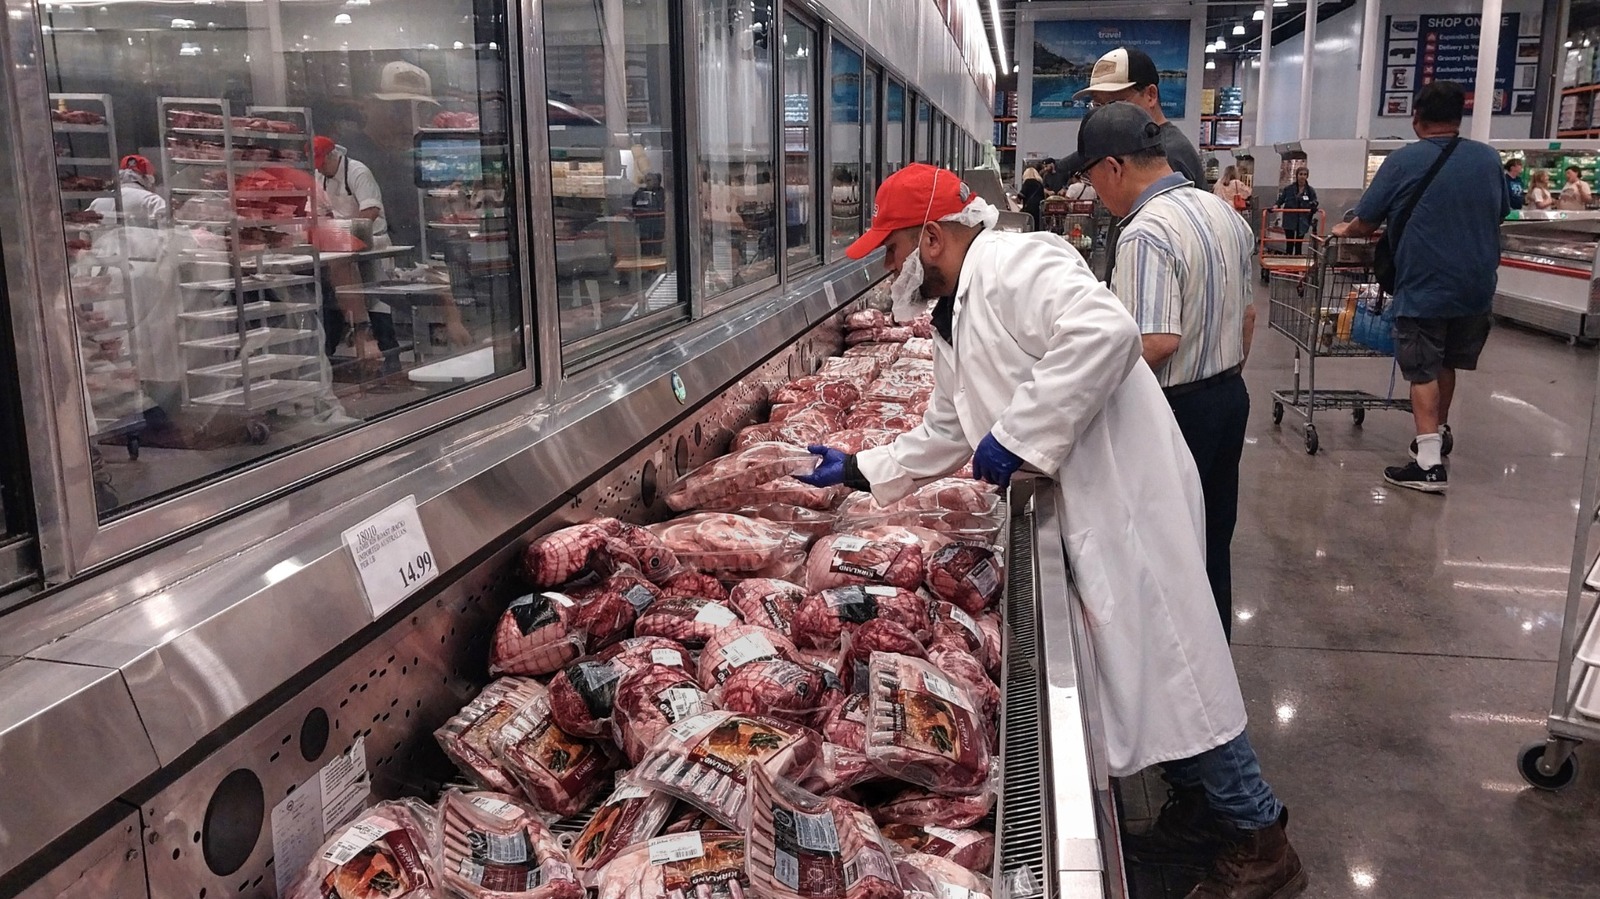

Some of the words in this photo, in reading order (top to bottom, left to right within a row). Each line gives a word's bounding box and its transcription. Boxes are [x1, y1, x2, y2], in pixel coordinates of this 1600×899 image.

[1428, 17, 1462, 28] SHOP
[1464, 16, 1509, 28] ONE
[1098, 31, 1122, 39] travel
[356, 525, 377, 545] 18010
[358, 543, 381, 561] IMPORTED
[380, 528, 407, 547] AUSTRALIAN
[399, 551, 432, 588] 14.99
[838, 565, 874, 578] KIRKLAND
[763, 600, 786, 630] KIRKLAND
[704, 756, 734, 774] KIRKLAND
[692, 871, 738, 885] KIRKLAND
